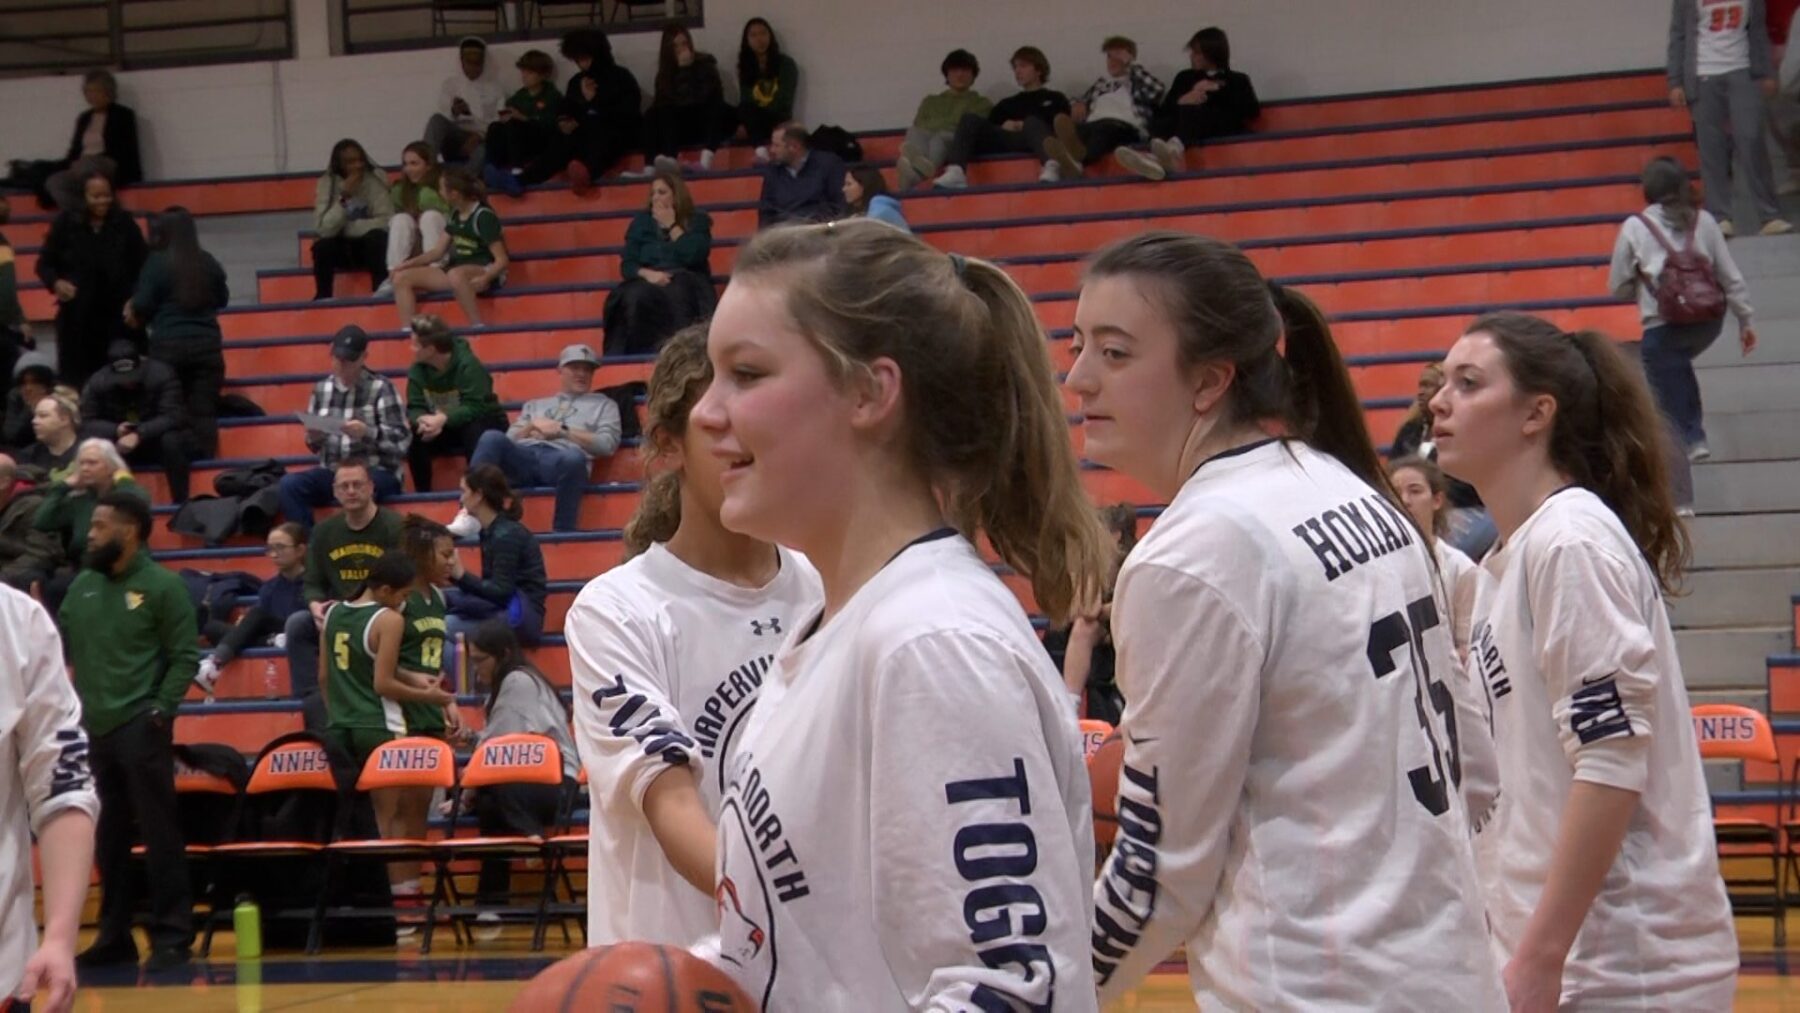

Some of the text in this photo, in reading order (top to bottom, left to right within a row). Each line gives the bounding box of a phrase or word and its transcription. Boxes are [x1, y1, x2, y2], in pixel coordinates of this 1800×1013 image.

[334, 631, 350, 670] 5
[694, 654, 774, 758] NAPERVI
[1366, 594, 1461, 816] 35
[1693, 717, 1755, 740] NHS
[270, 750, 328, 774] NNHS
[379, 748, 439, 770] NNHS
[484, 743, 546, 766] NNHS
